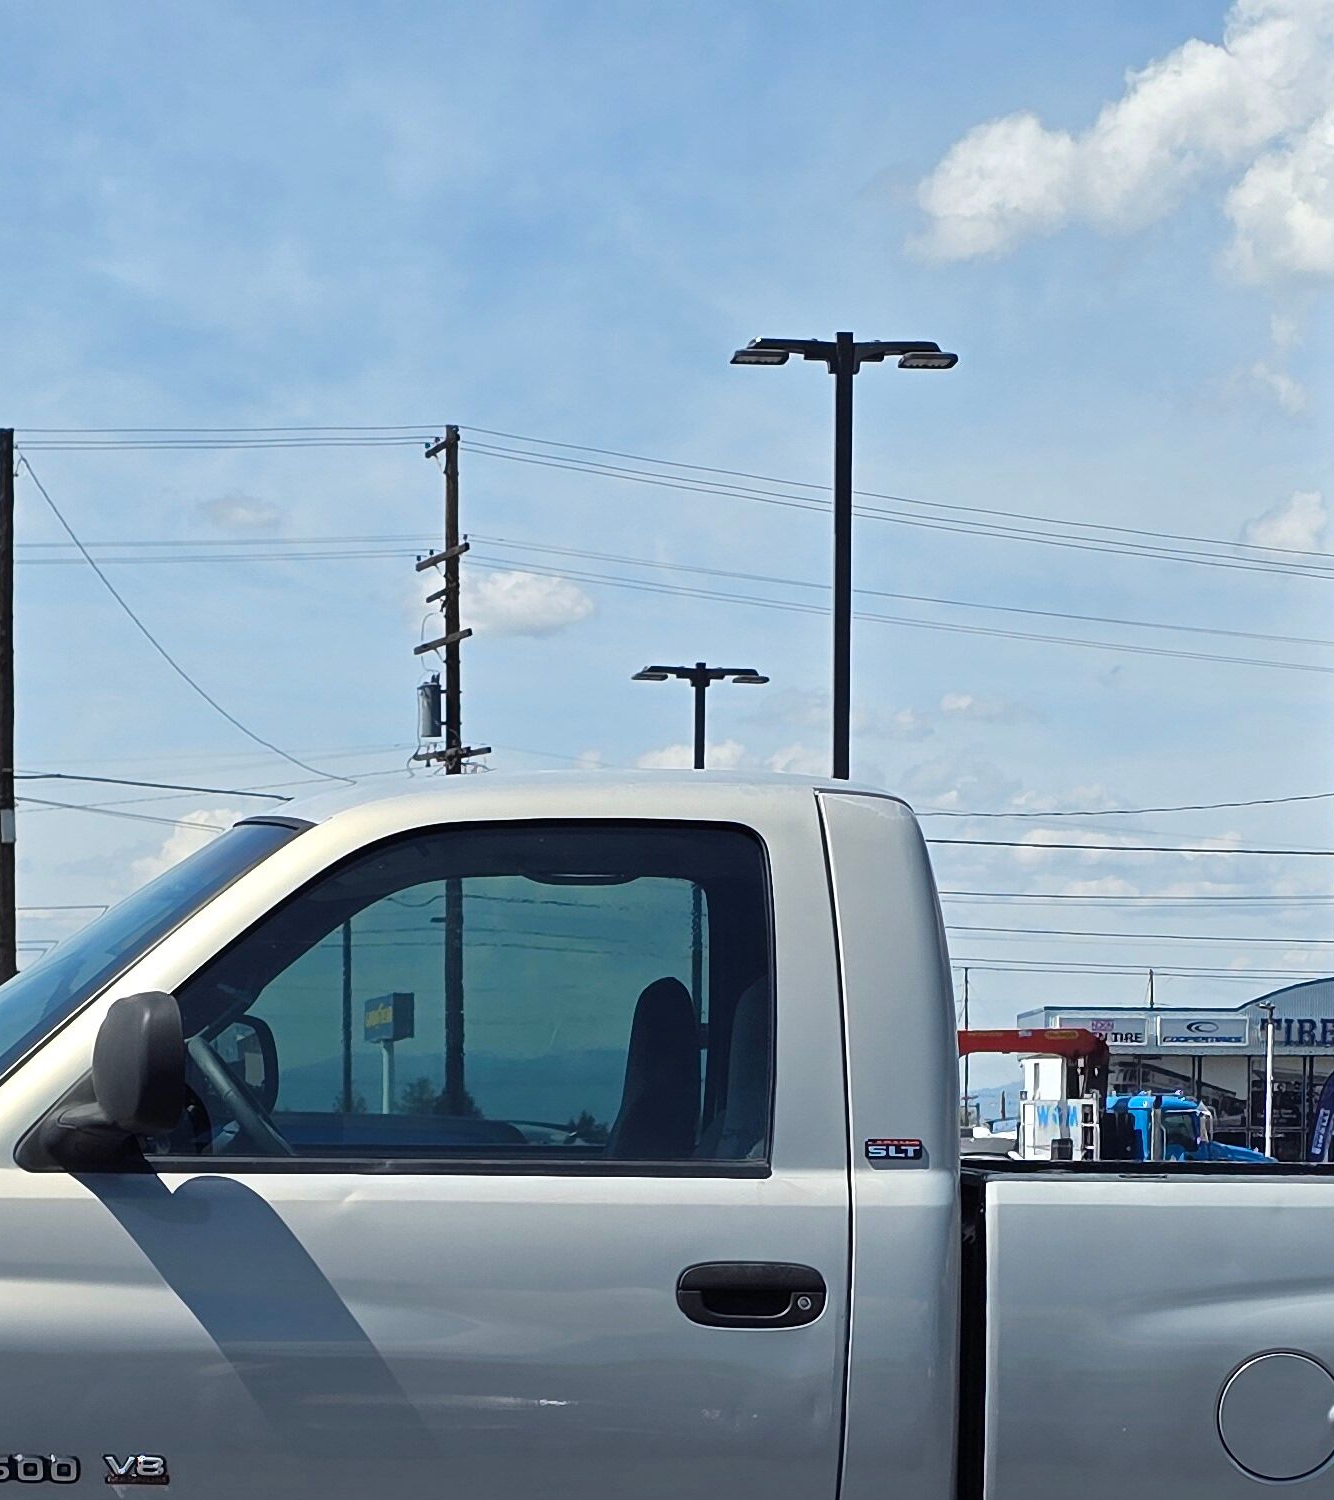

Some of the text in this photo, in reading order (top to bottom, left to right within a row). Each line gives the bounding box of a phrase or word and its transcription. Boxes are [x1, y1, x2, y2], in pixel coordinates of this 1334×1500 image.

[1111, 1032, 1142, 1043] TIRE
[868, 1146, 920, 1157] SLT
[103, 1452, 168, 1480] V8
